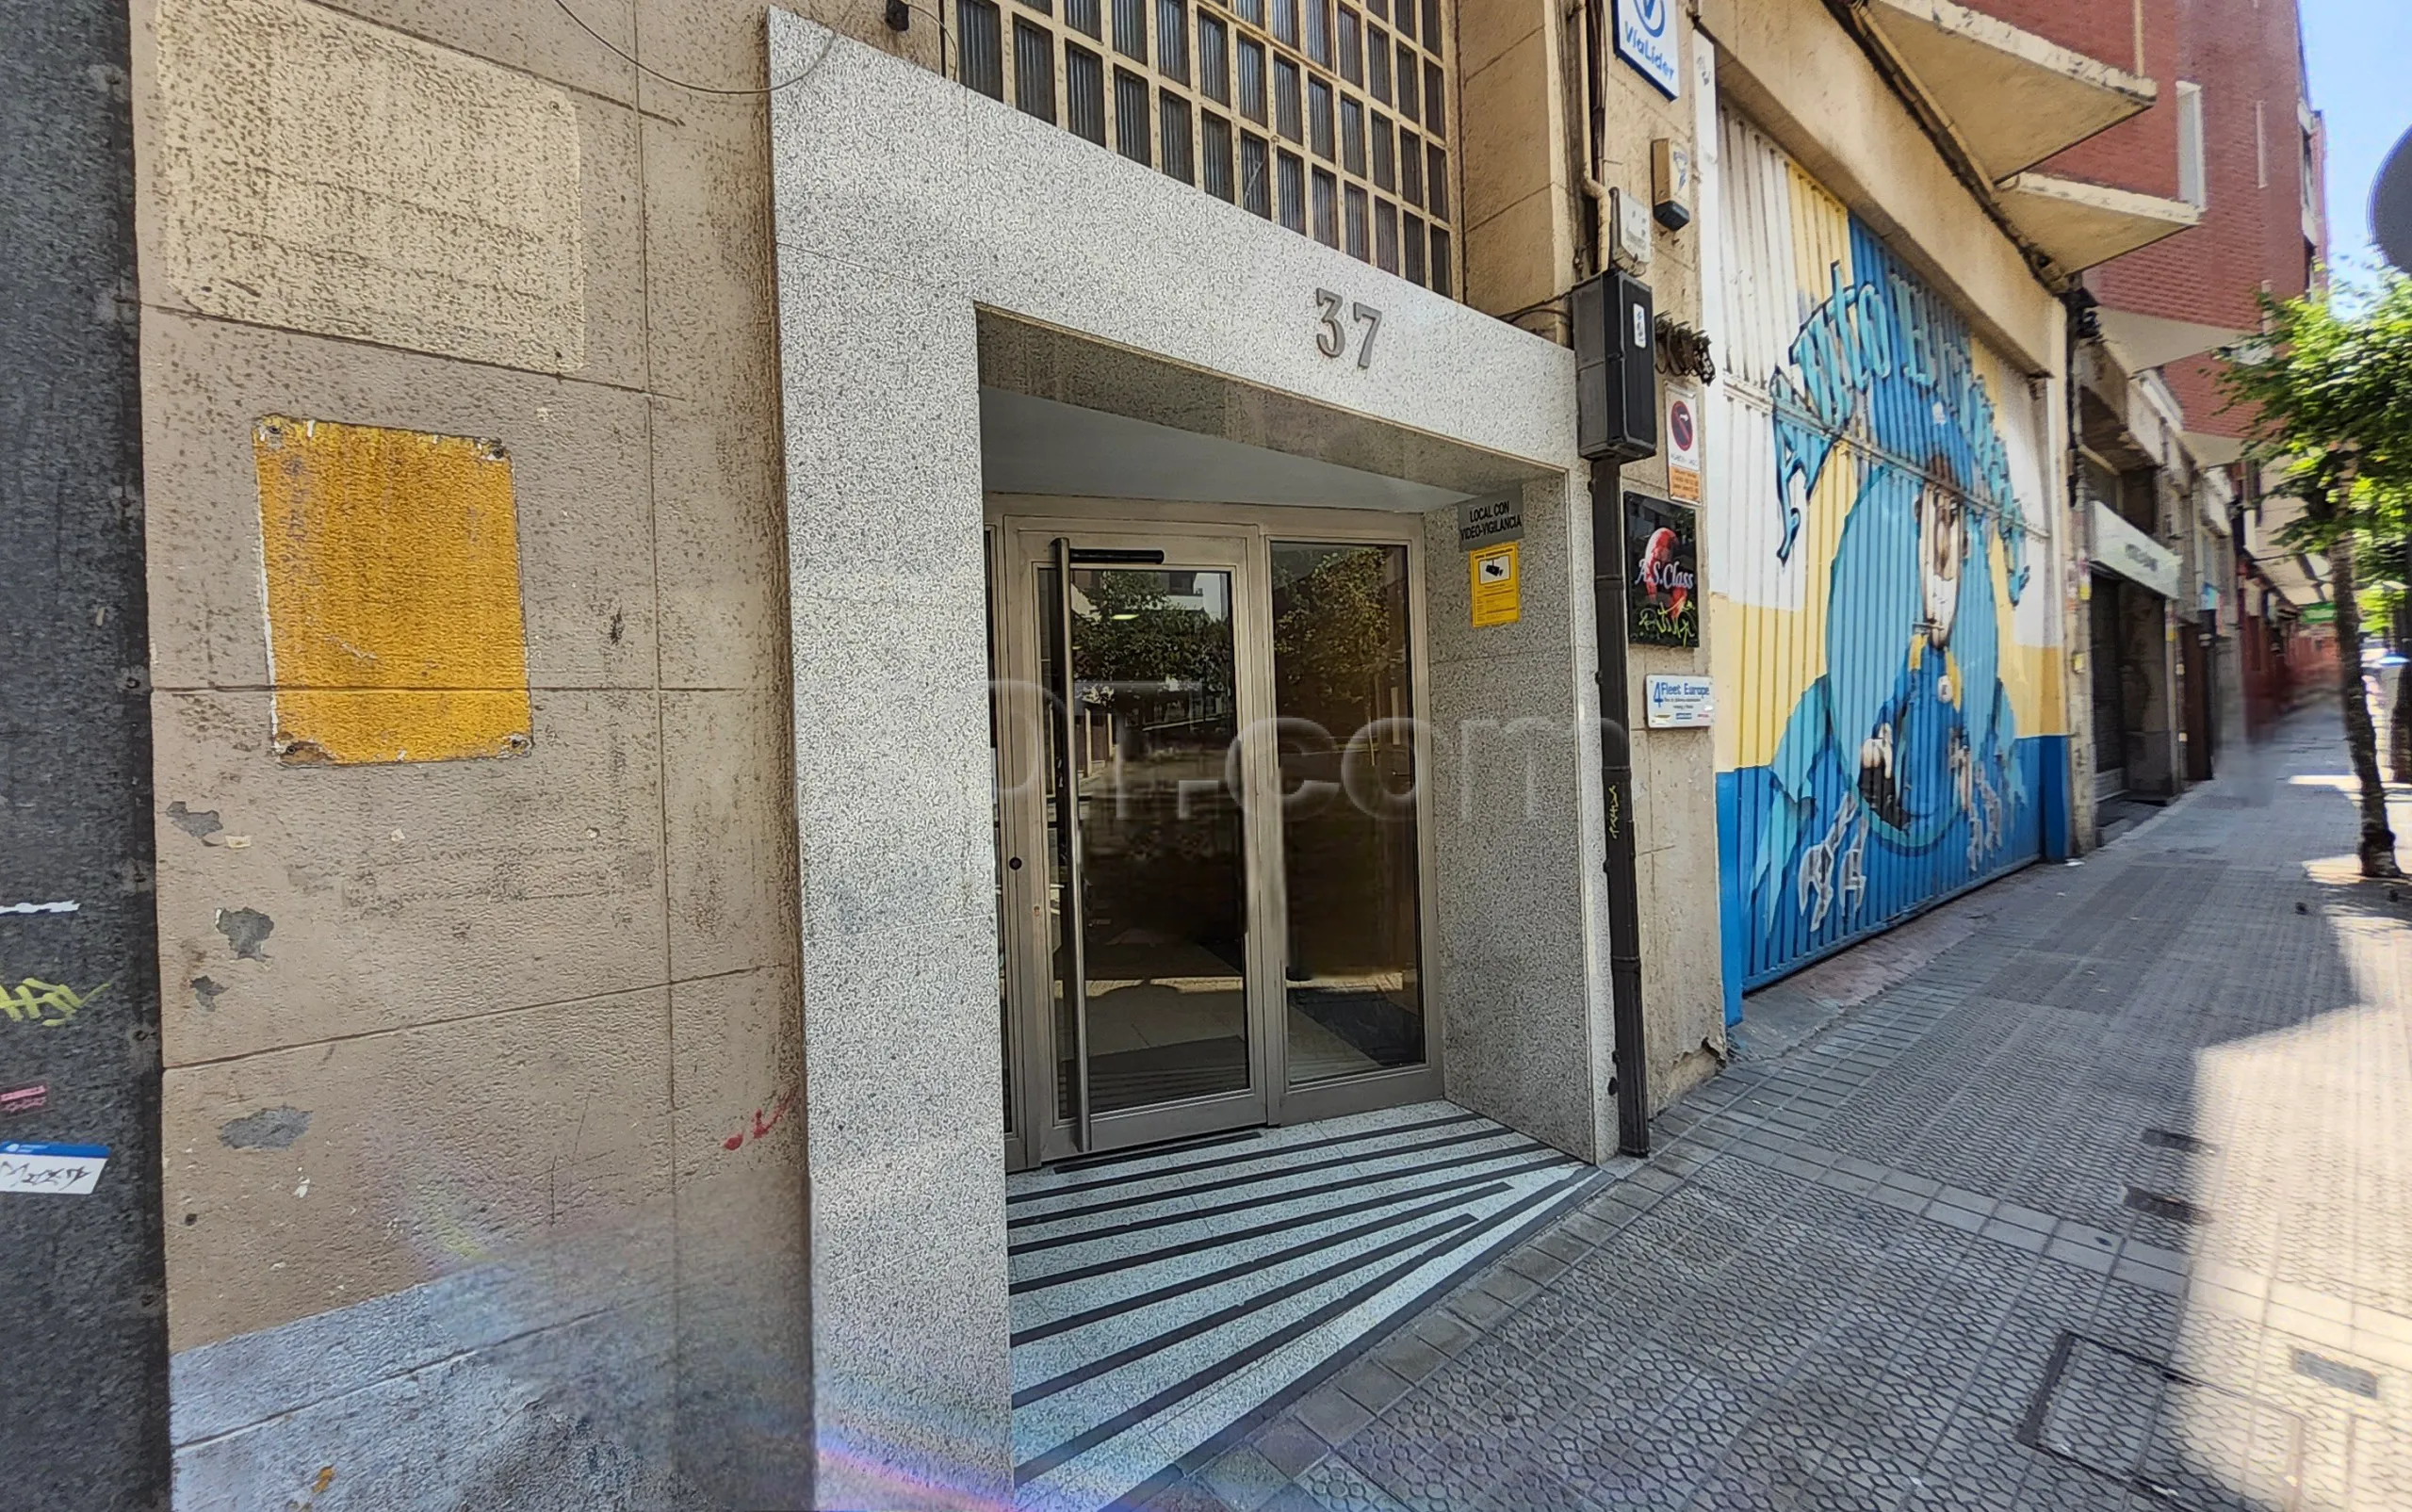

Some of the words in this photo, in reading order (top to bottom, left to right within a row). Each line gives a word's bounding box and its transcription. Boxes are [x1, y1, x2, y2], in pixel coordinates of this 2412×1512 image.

[1315, 286, 1382, 369] 37
[1469, 504, 1493, 523] LOCAL
[1493, 500, 1509, 514] CON
[1460, 514, 1523, 541] VIDEO-VIGILANCIA
[1684, 682, 1710, 699] Europe
